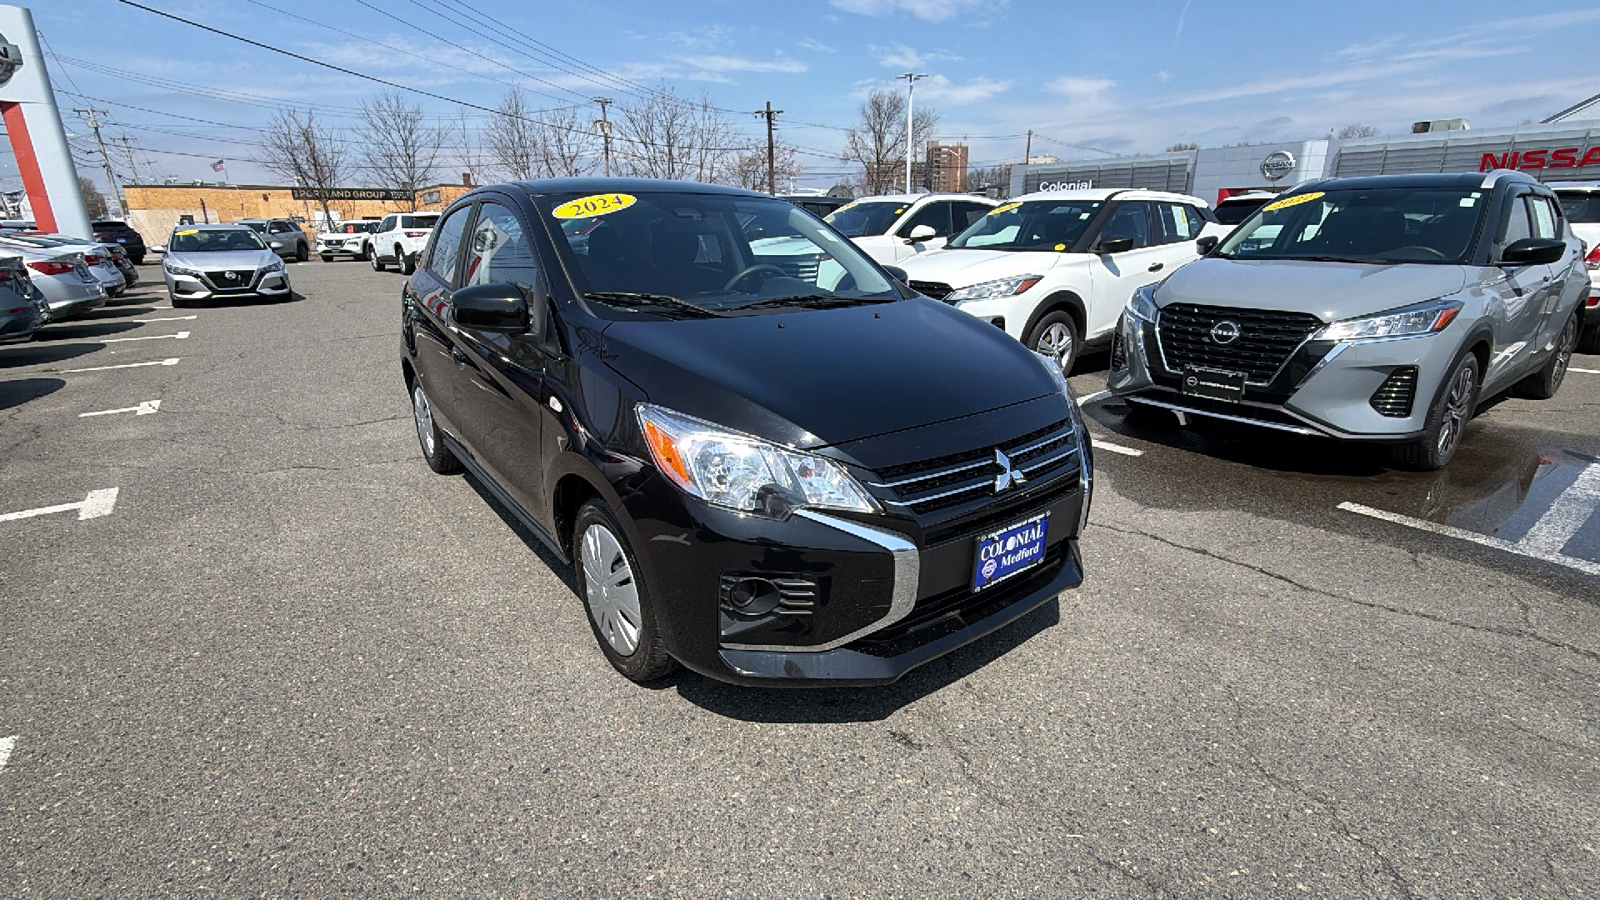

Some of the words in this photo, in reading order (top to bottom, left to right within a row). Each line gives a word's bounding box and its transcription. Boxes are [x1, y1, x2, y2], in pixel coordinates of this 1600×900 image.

[352, 189, 386, 199] GROUP
[1039, 179, 1093, 192] Colonial
[569, 195, 623, 216] 2024
[981, 524, 1044, 562] COLONIAL
[1000, 542, 1040, 569] Medford
